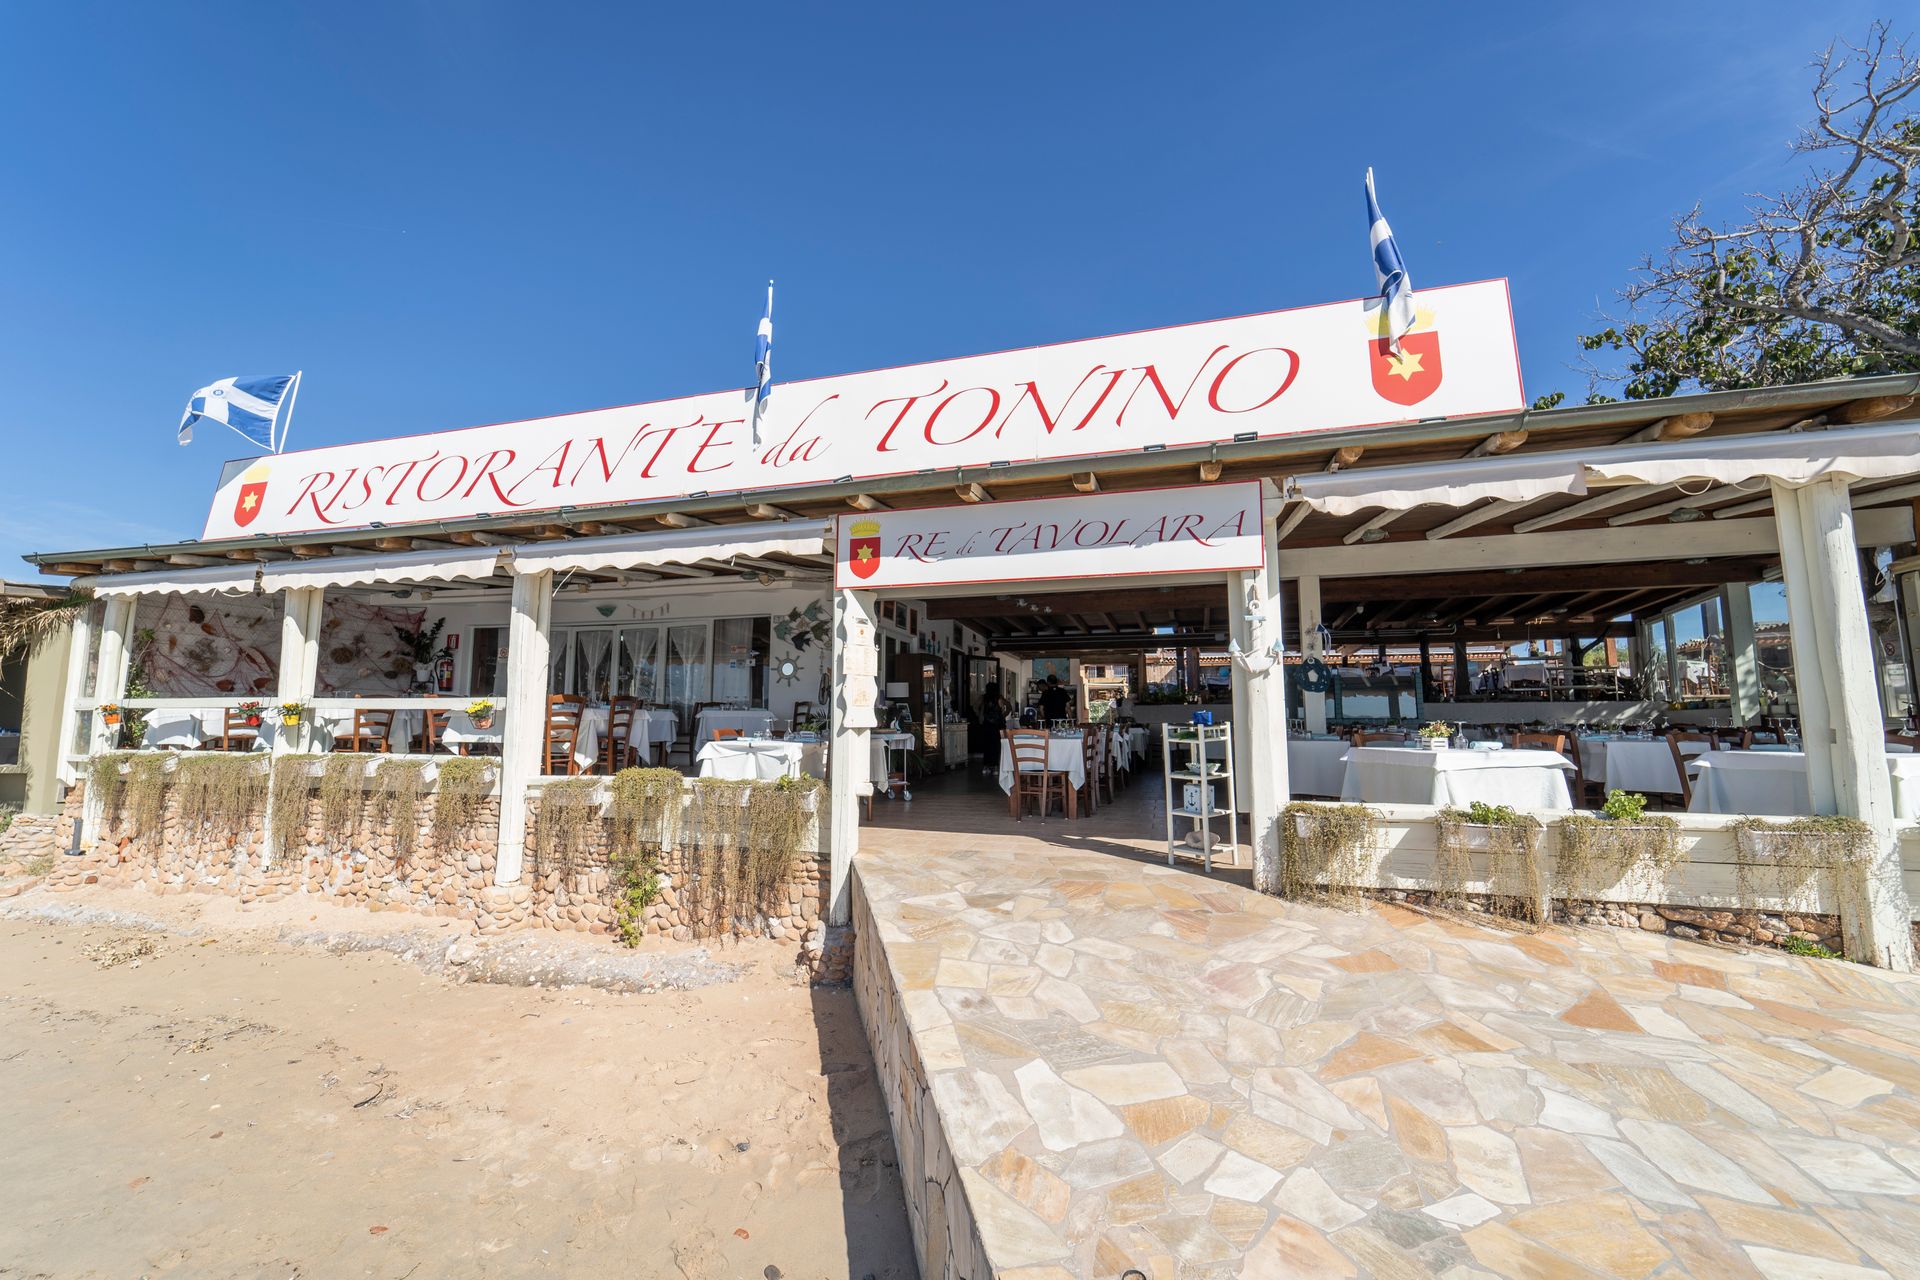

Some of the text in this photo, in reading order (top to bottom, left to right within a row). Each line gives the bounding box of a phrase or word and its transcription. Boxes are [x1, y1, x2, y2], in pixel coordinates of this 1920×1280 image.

[285, 344, 1301, 525] RISTORANTE da TONINO
[894, 509, 1247, 563] RE di TAVOLARA
